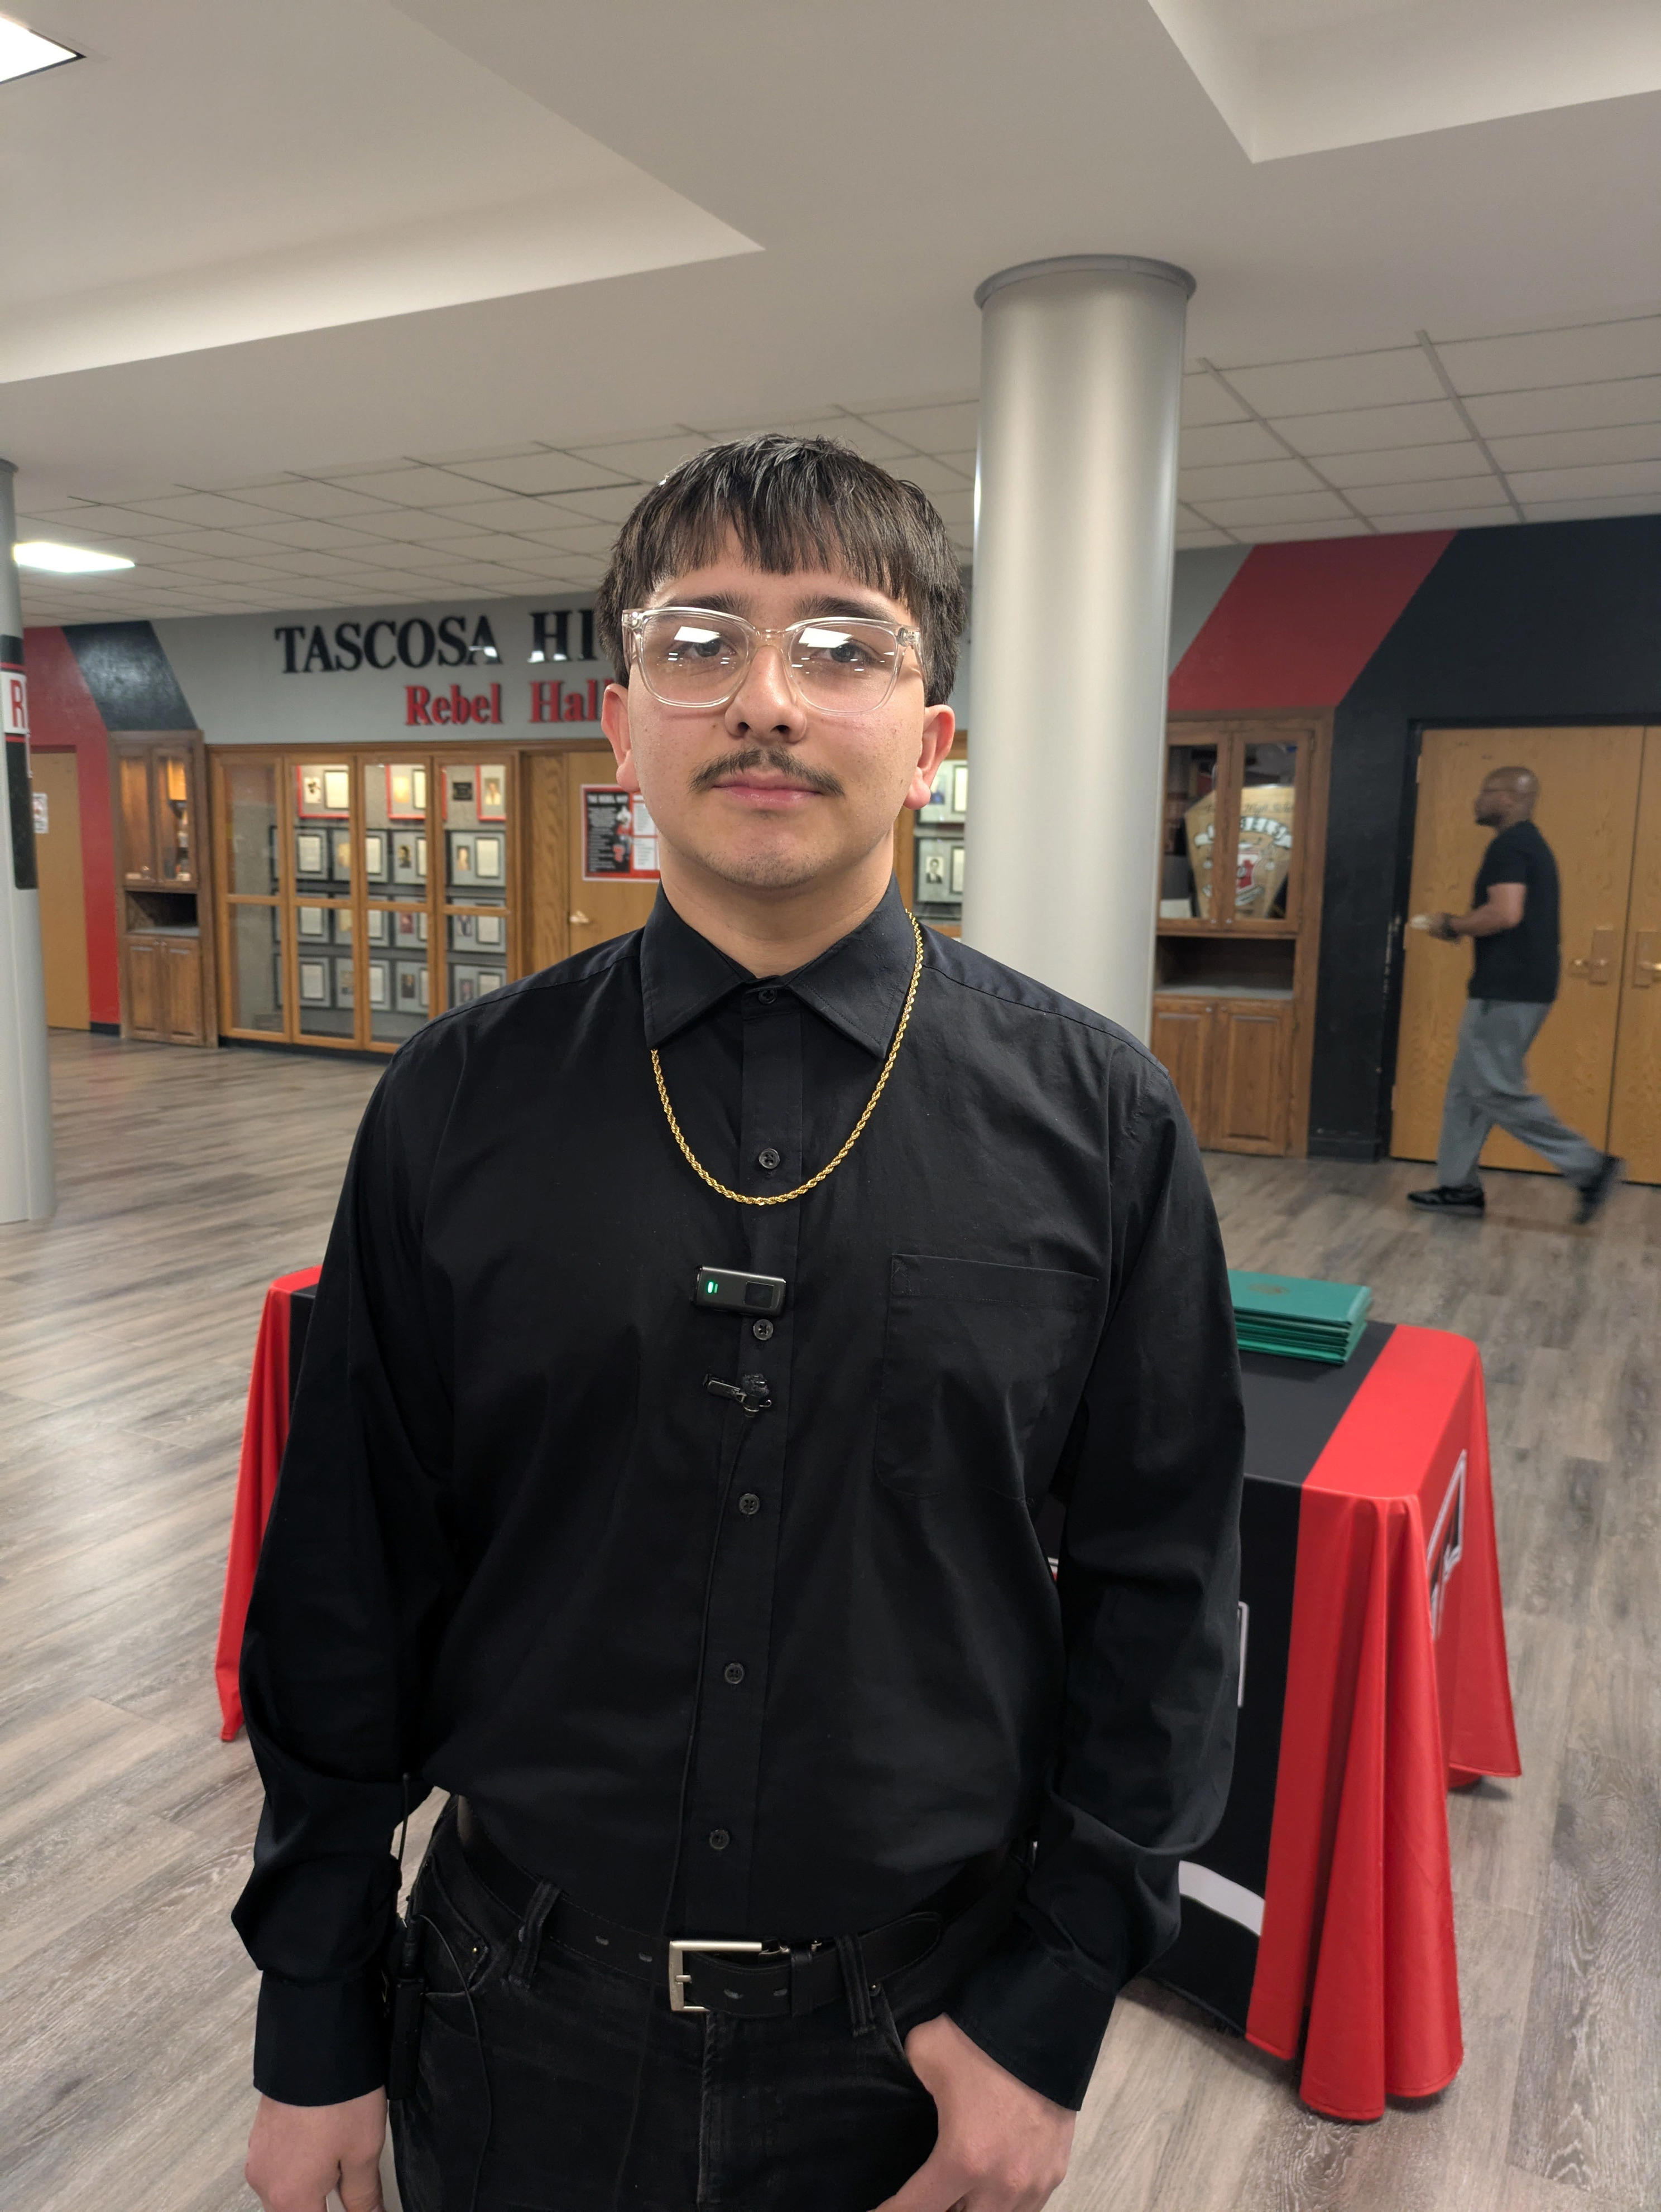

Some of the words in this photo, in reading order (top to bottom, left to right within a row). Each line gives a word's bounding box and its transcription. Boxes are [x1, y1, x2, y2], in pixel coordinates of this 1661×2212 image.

[275, 614, 503, 674] TASCOSA
[405, 683, 503, 725] Rebel
[529, 677, 615, 723] Hal
